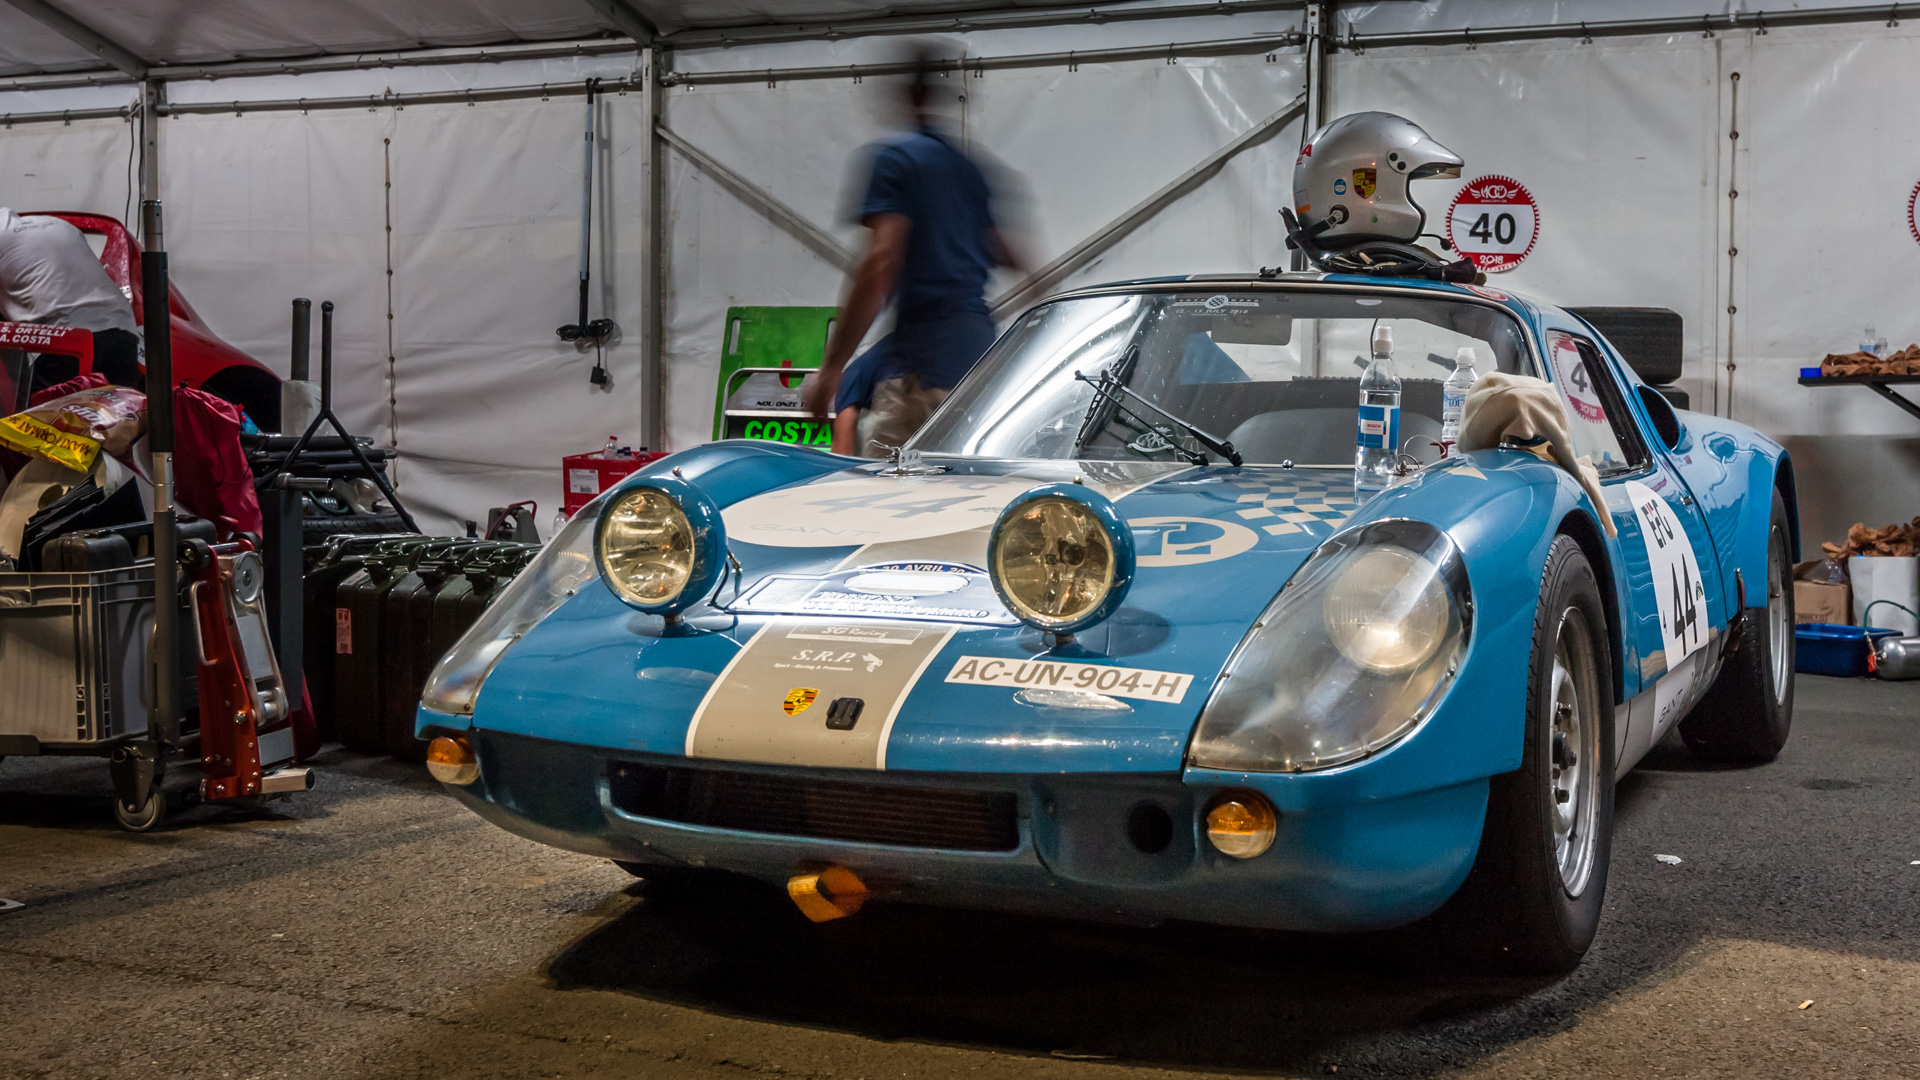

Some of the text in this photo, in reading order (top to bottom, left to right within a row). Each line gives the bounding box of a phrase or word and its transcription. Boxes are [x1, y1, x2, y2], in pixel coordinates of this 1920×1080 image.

[1468, 212, 1516, 245] 40
[1480, 254, 1504, 265] 2018
[0, 334, 51, 346] A. COSTA
[15, 327, 67, 337] ORTELLI
[17, 420, 63, 448] FORMAT
[744, 420, 832, 446] COSTA
[60, 438, 93, 456] MAXI
[803, 490, 987, 519] 44
[750, 523, 881, 537] GANT
[903, 563, 944, 573] AVRIL
[1671, 553, 1698, 657] 44
[821, 626, 889, 639] SG Racing
[791, 649, 857, 663] S.R.P.
[952, 658, 1183, 698] AC-UN-904-H
